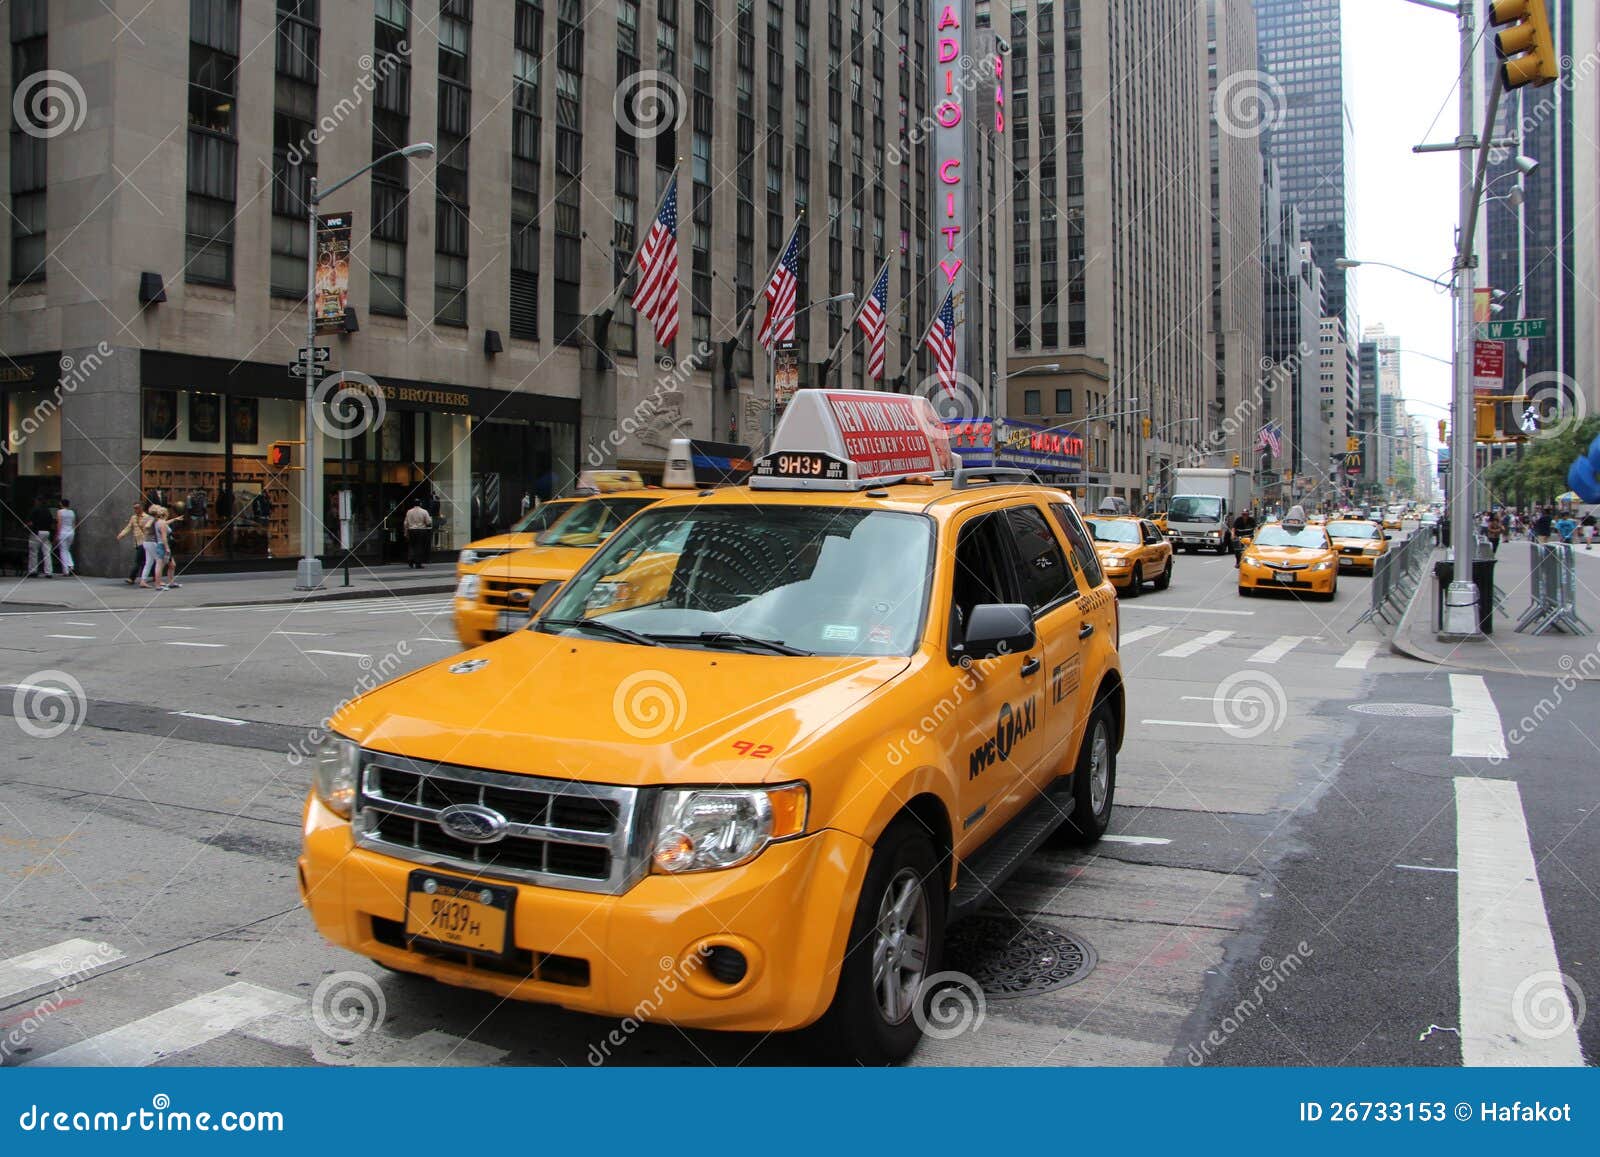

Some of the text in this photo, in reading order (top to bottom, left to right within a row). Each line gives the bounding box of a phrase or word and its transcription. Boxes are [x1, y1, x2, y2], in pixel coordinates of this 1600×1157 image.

[940, 159, 963, 285] CITY
[1491, 323, 1503, 337] W
[1513, 322, 1528, 337] 51
[340, 381, 470, 407] BROOKS BROTHERS
[831, 400, 919, 432] NEW YORK DOLLS
[847, 435, 927, 456] GENTLEMEN'S CLUB
[1030, 431, 1060, 453] RADIO
[1064, 436, 1084, 456] CITY
[778, 456, 822, 475] 9H39
[732, 740, 774, 759] 92
[431, 898, 470, 931] 9H39
